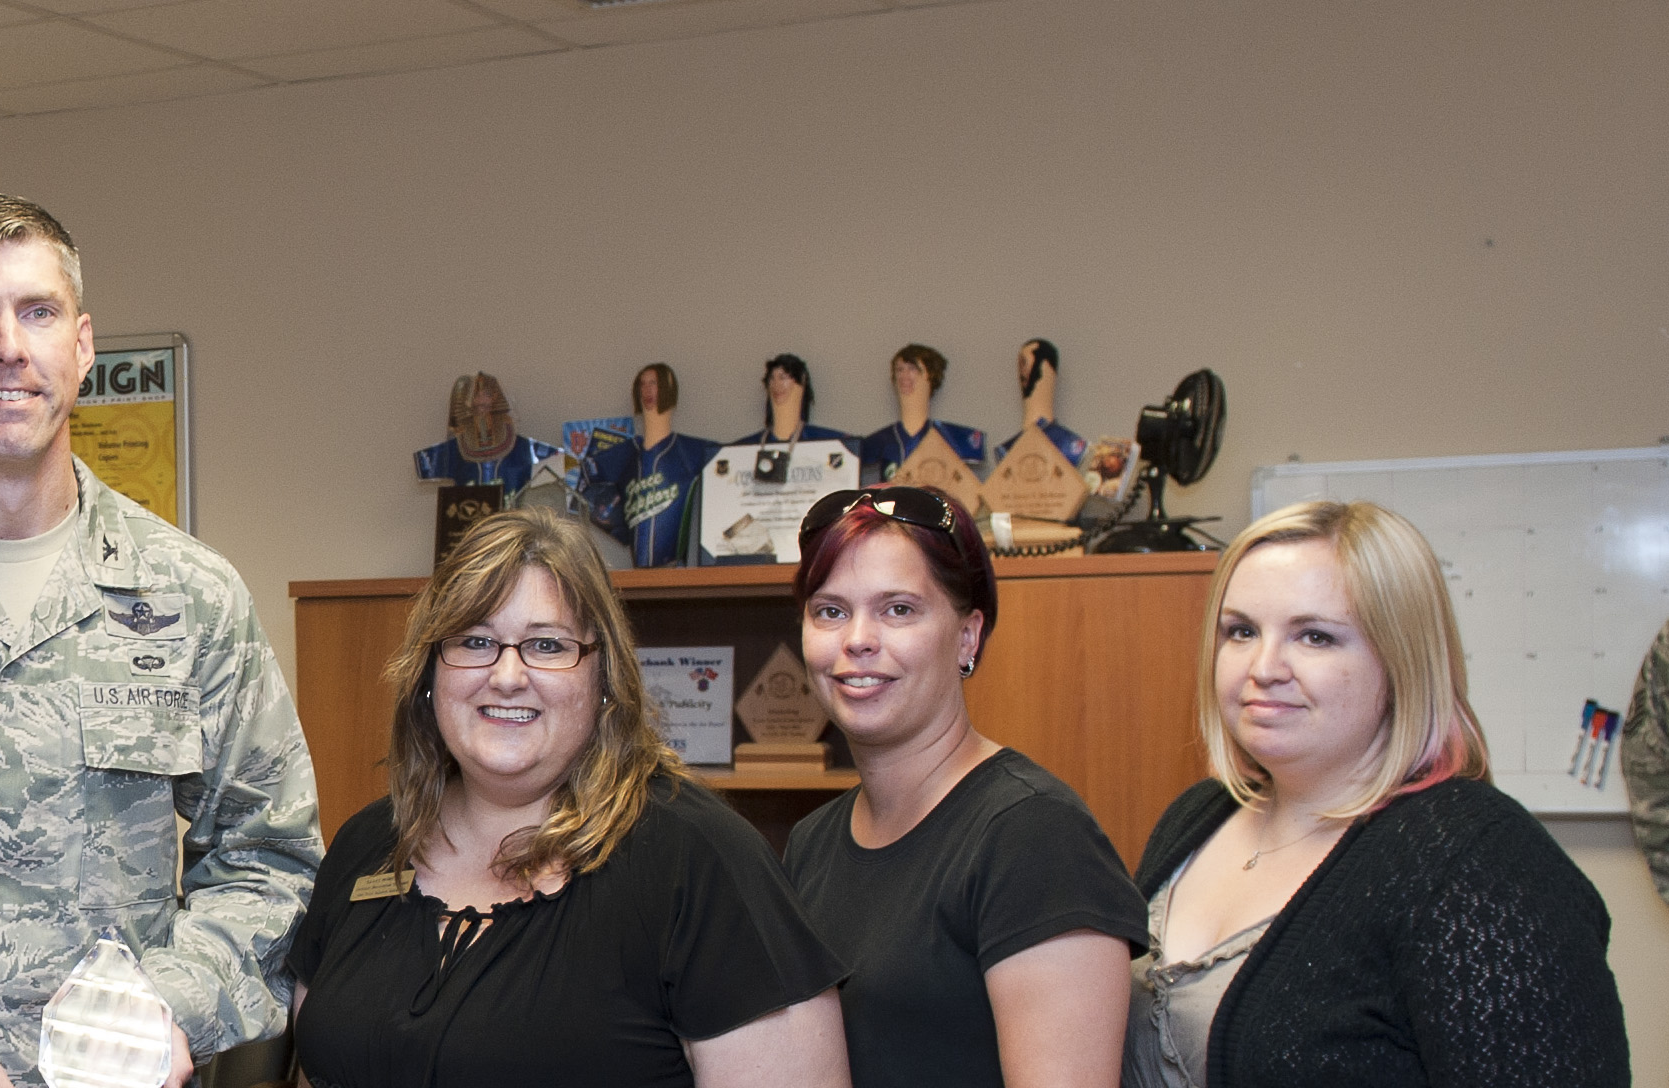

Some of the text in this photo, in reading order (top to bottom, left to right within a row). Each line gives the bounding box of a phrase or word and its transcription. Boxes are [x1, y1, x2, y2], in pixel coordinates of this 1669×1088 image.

[678, 656, 723, 666] Winner
[93, 687, 189, 709] U.S. AIR FORCE
